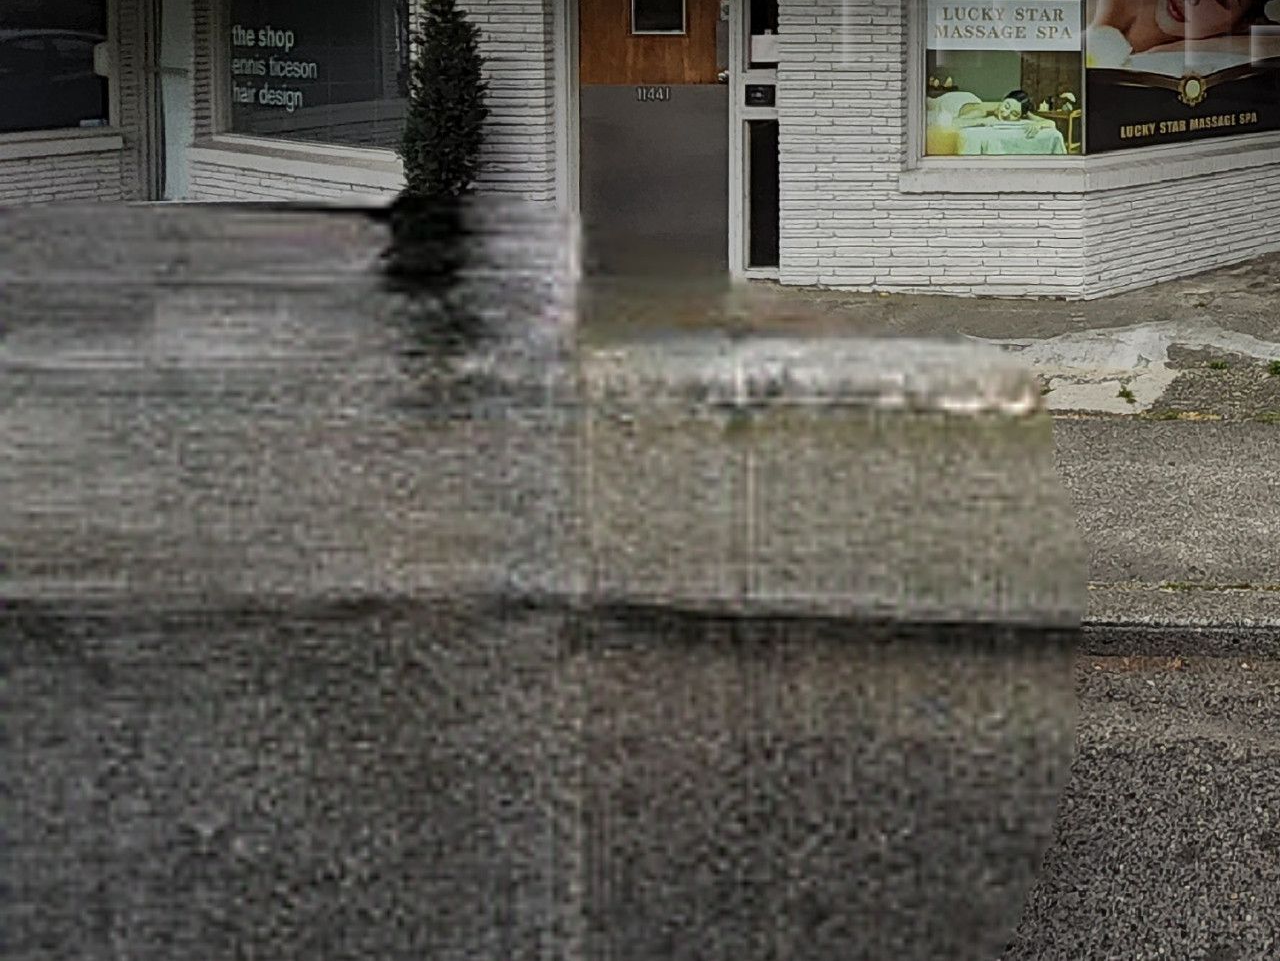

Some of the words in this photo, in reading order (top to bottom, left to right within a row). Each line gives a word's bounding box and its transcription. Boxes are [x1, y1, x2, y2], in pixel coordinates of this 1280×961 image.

[943, 6, 1005, 21] LUCKY
[1015, 7, 1064, 22] STAR
[232, 24, 256, 46] the
[258, 24, 295, 52] shop
[934, 24, 1027, 39] MASSAGE
[1036, 25, 1073, 40] SPA
[232, 80, 256, 103] hair
[258, 82, 303, 112] design
[637, 87, 669, 100] 11441
[1120, 123, 1156, 139] LUCKY
[1159, 120, 1186, 134] STAR
[1189, 114, 1237, 131] MASSAGE
[1239, 112, 1258, 125] SPA
